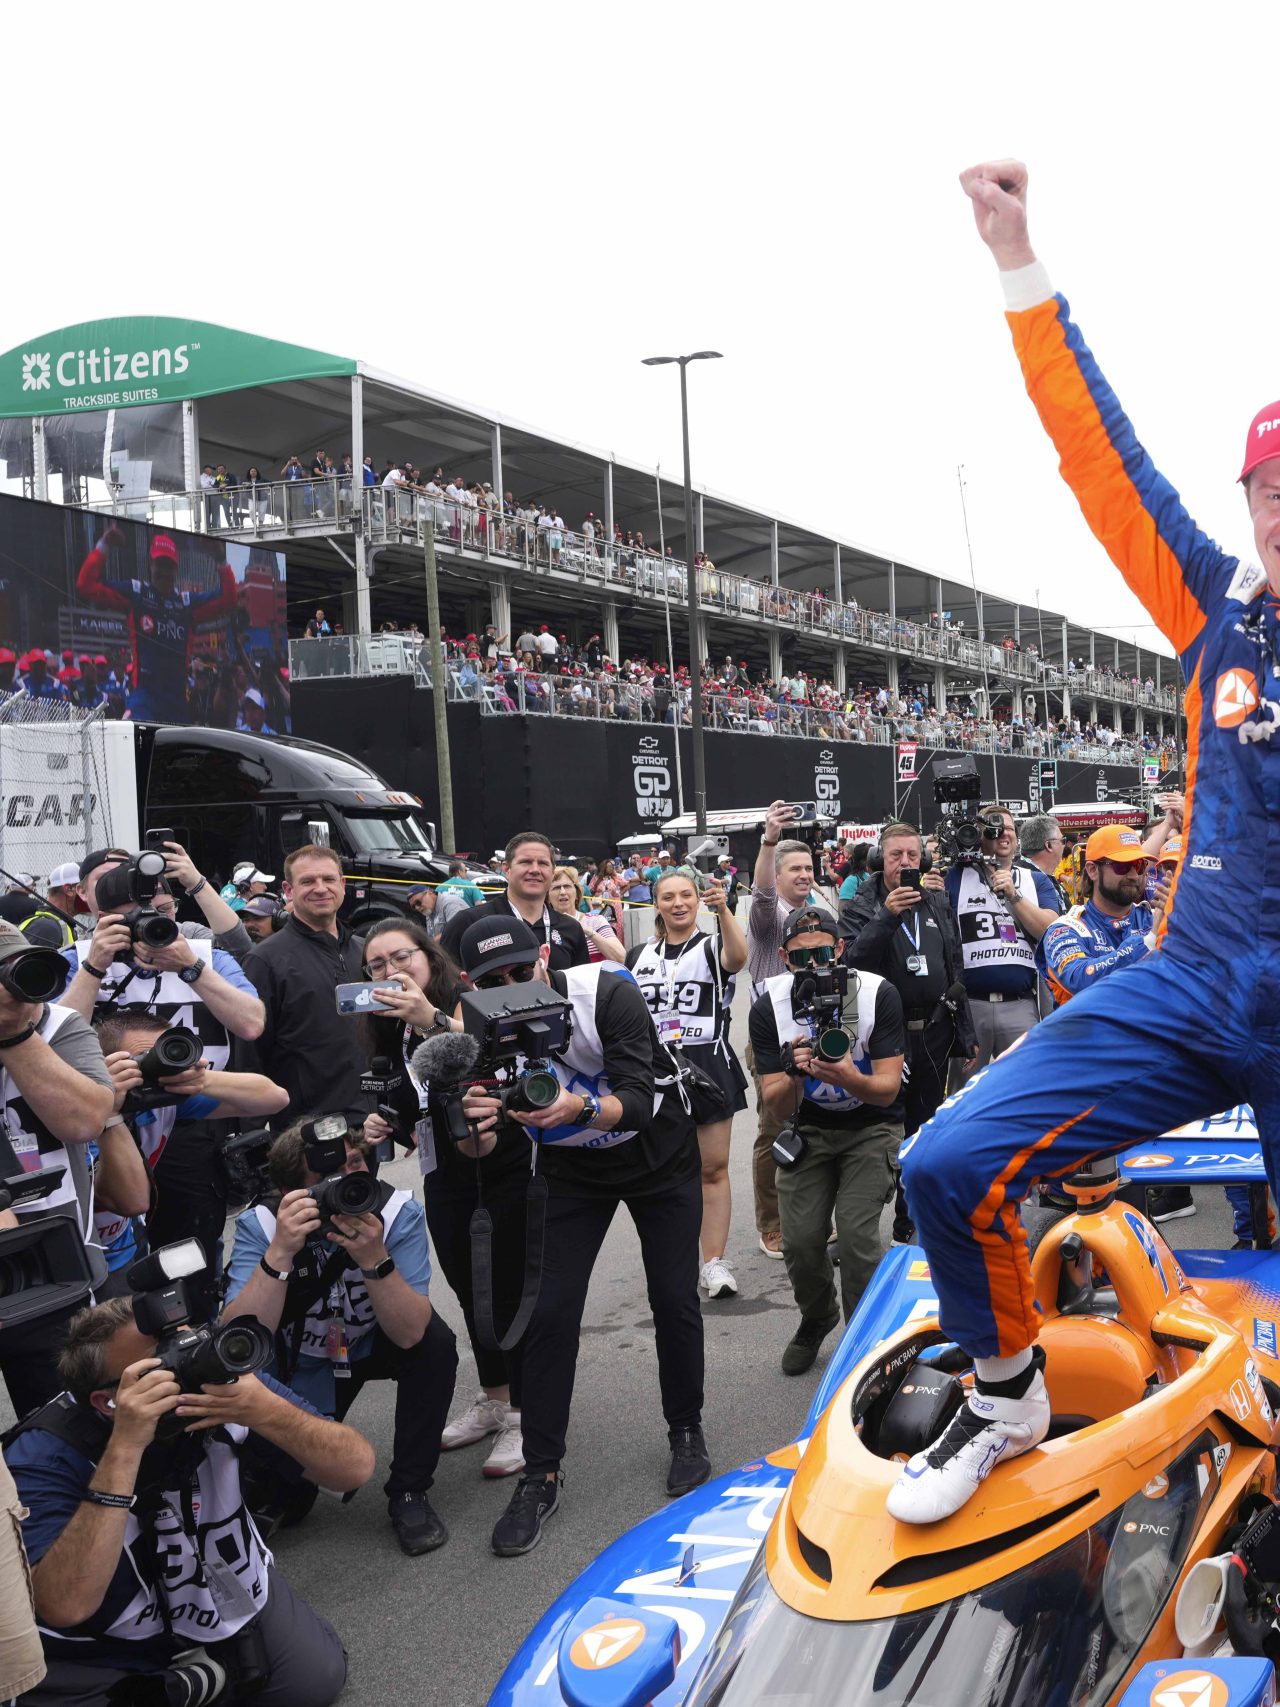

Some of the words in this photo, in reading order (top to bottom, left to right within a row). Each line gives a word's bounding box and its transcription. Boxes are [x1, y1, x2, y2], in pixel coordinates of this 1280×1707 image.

[56, 346, 189, 387] Citizens
[64, 393, 120, 408] TRACKSIDE
[122, 388, 159, 402] SUITES
[157, 622, 185, 641] PNC
[632, 755, 668, 766] DETROIT
[900, 755, 914, 770] 45
[815, 766, 839, 774] DETROIT
[634, 766, 670, 796] GP
[815, 774, 840, 799] GP
[2, 794, 97, 827] CAR
[1057, 819, 1094, 827] elivered
[1096, 817, 1117, 825] with
[1118, 816, 1145, 825] pride.
[841, 828, 876, 840] HyVee
[1190, 855, 1222, 870] sparco
[970, 948, 1033, 961] PHOTO/VIDEO
[14, 1138, 35, 1148] DIA
[328, 1175, 342, 1183] Canon
[180, 1336, 198, 1345] Canon
[915, 1385, 941, 1396] PNC
[1139, 1523, 1170, 1536] PNC
[984, 1624, 1009, 1677] SIMPSON
[1087, 1632, 1103, 1688] SIMPSON
